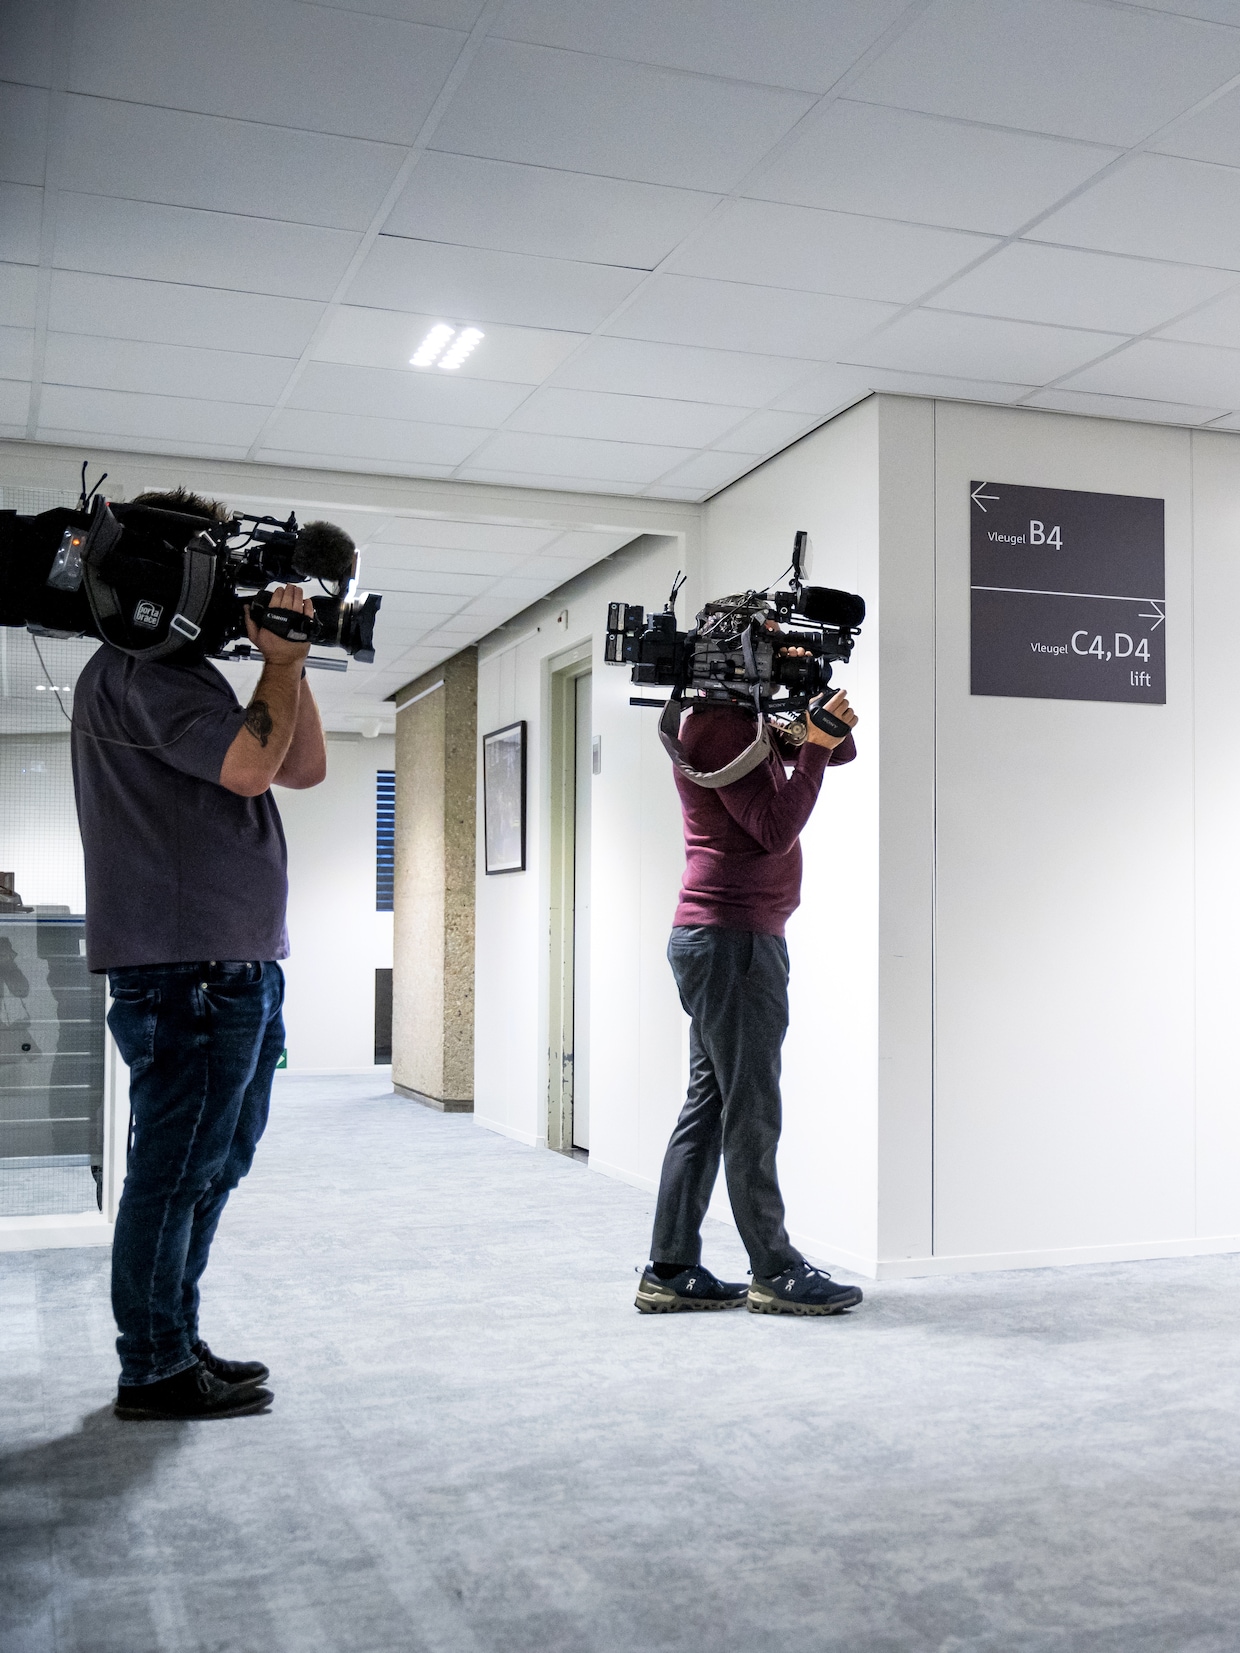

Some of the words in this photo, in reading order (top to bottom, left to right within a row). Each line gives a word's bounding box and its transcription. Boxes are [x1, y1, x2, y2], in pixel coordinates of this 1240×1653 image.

[987, 531, 1026, 546] Vleugel
[1029, 519, 1063, 550] B4
[136, 613, 158, 624] brace
[266, 612, 288, 622] Canon
[1031, 642, 1068, 656] Vleugel
[1071, 630, 1151, 662] C4,D4
[1130, 670, 1151, 687] lift
[822, 717, 839, 729] SONY
